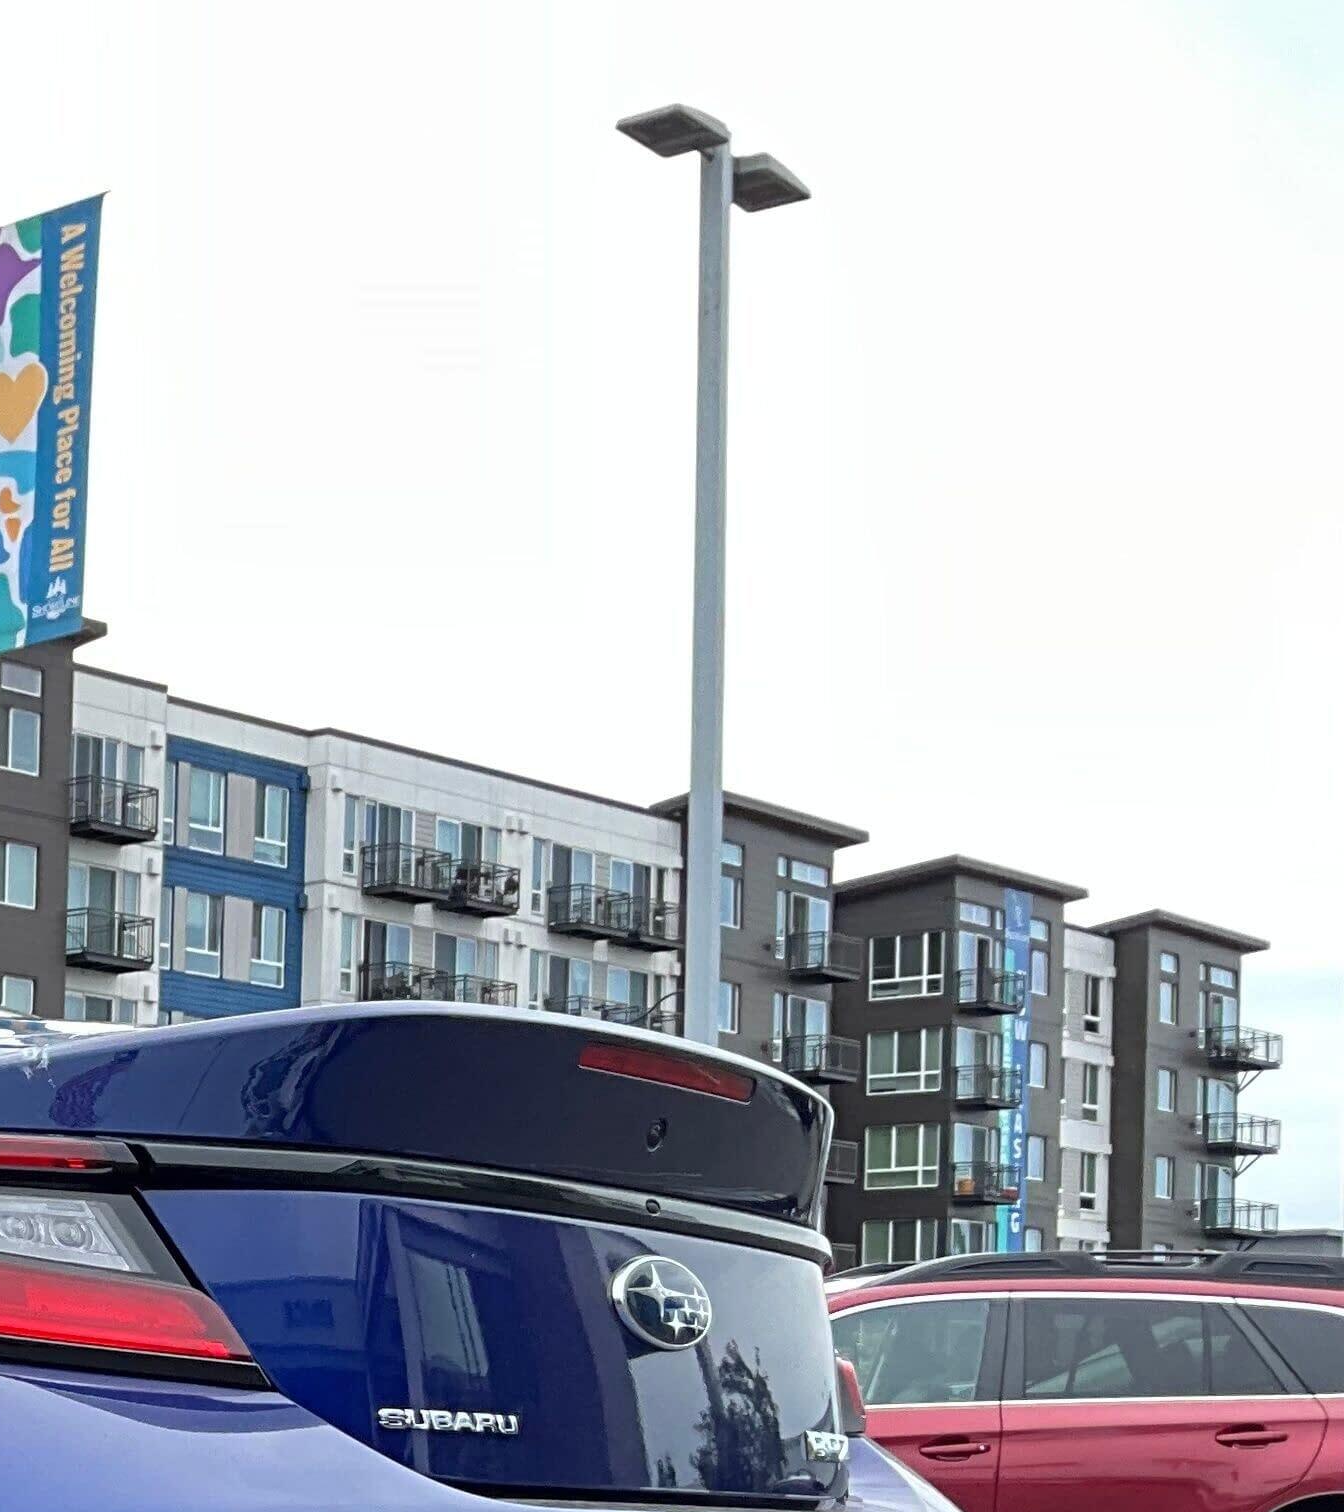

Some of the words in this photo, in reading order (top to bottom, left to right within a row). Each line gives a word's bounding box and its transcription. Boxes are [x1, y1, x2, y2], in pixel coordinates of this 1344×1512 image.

[61, 223, 87, 245] A
[53, 243, 86, 406] Welcoming
[54, 404, 81, 485] Place
[52, 488, 78, 530] for
[49, 538, 75, 573] All
[377, 1408, 520, 1435] SUBARU
